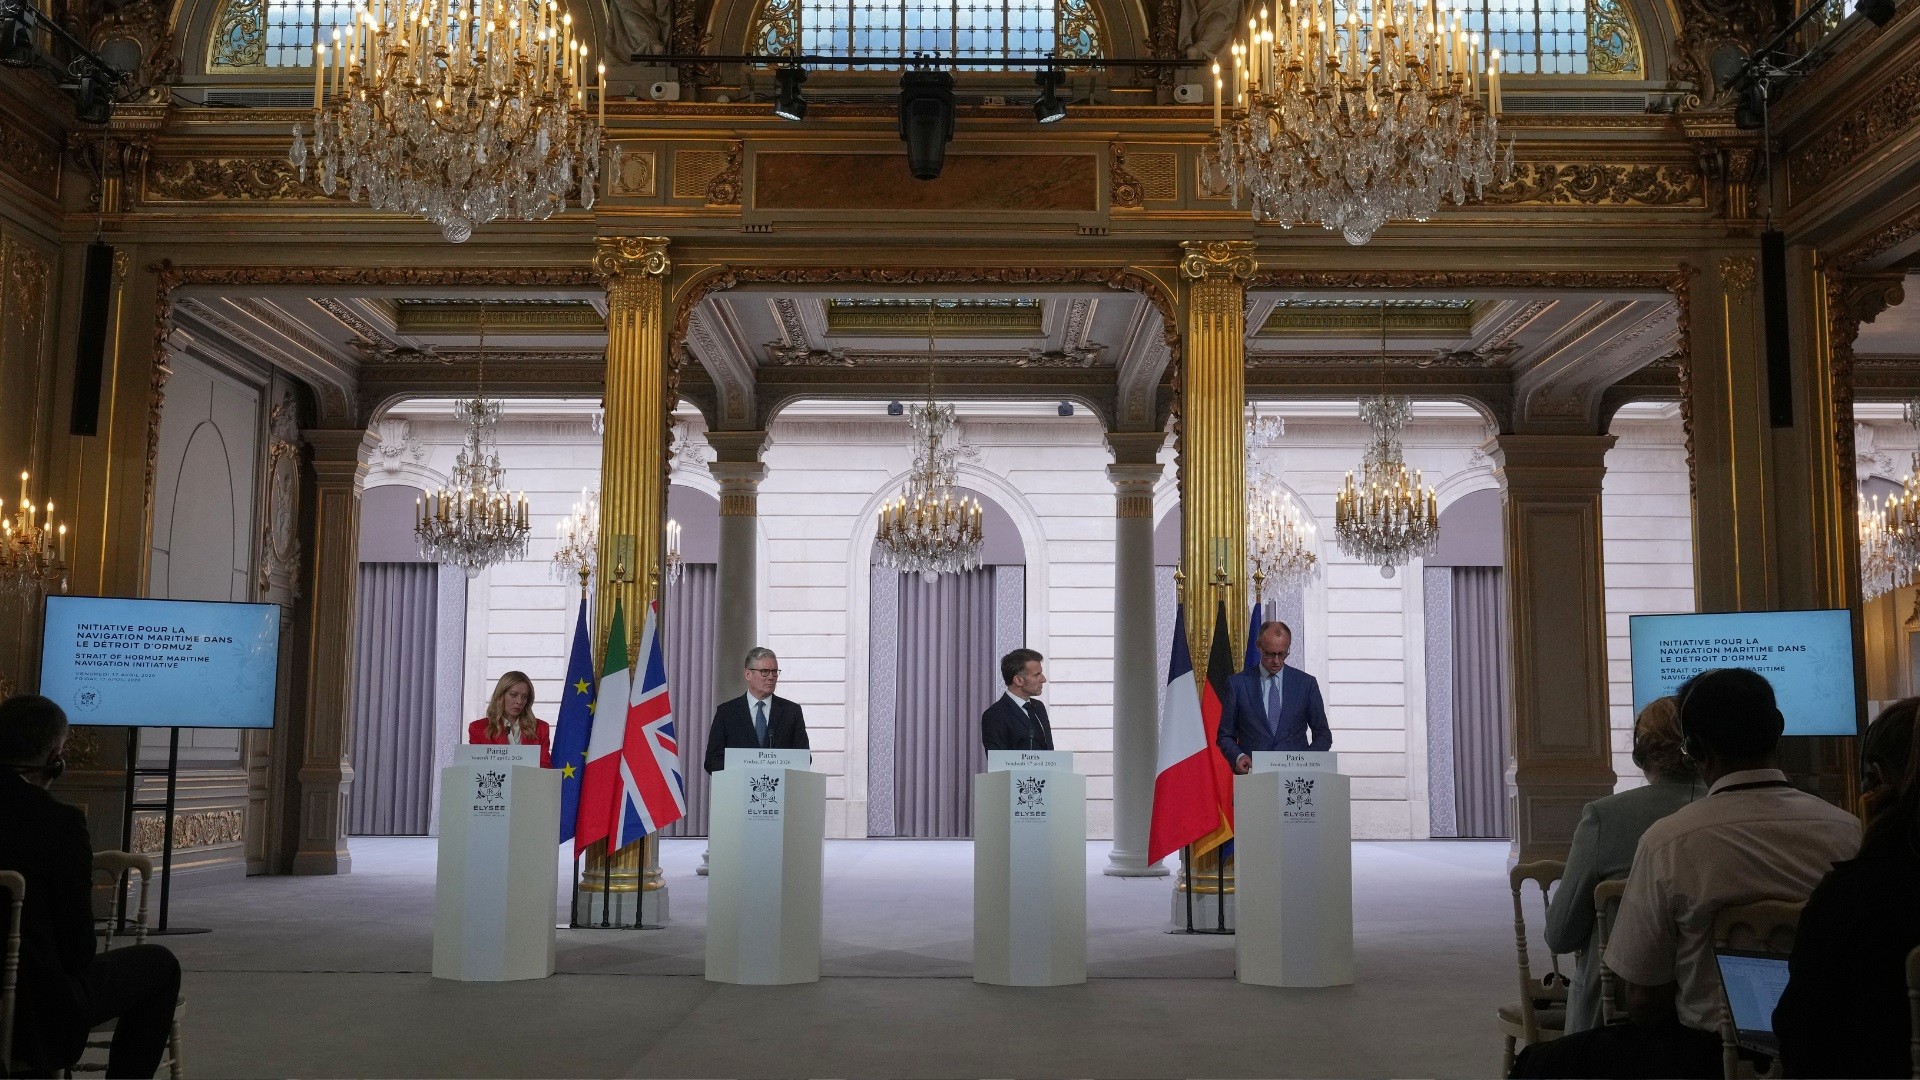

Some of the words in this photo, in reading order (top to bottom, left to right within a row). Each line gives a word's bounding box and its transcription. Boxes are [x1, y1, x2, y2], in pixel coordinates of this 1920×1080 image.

[78, 623, 134, 632] INITIATIVE
[77, 632, 143, 641] NAVIGATION
[148, 635, 200, 643] MARITIME
[204, 636, 233, 644] DANS
[93, 640, 139, 649] DÉTROIT
[1660, 646, 1720, 655] NAVIGATION
[1675, 654, 1717, 662] DÉTROIT
[133, 661, 178, 669] INITIATIVE
[486, 747, 508, 755] Parigi
